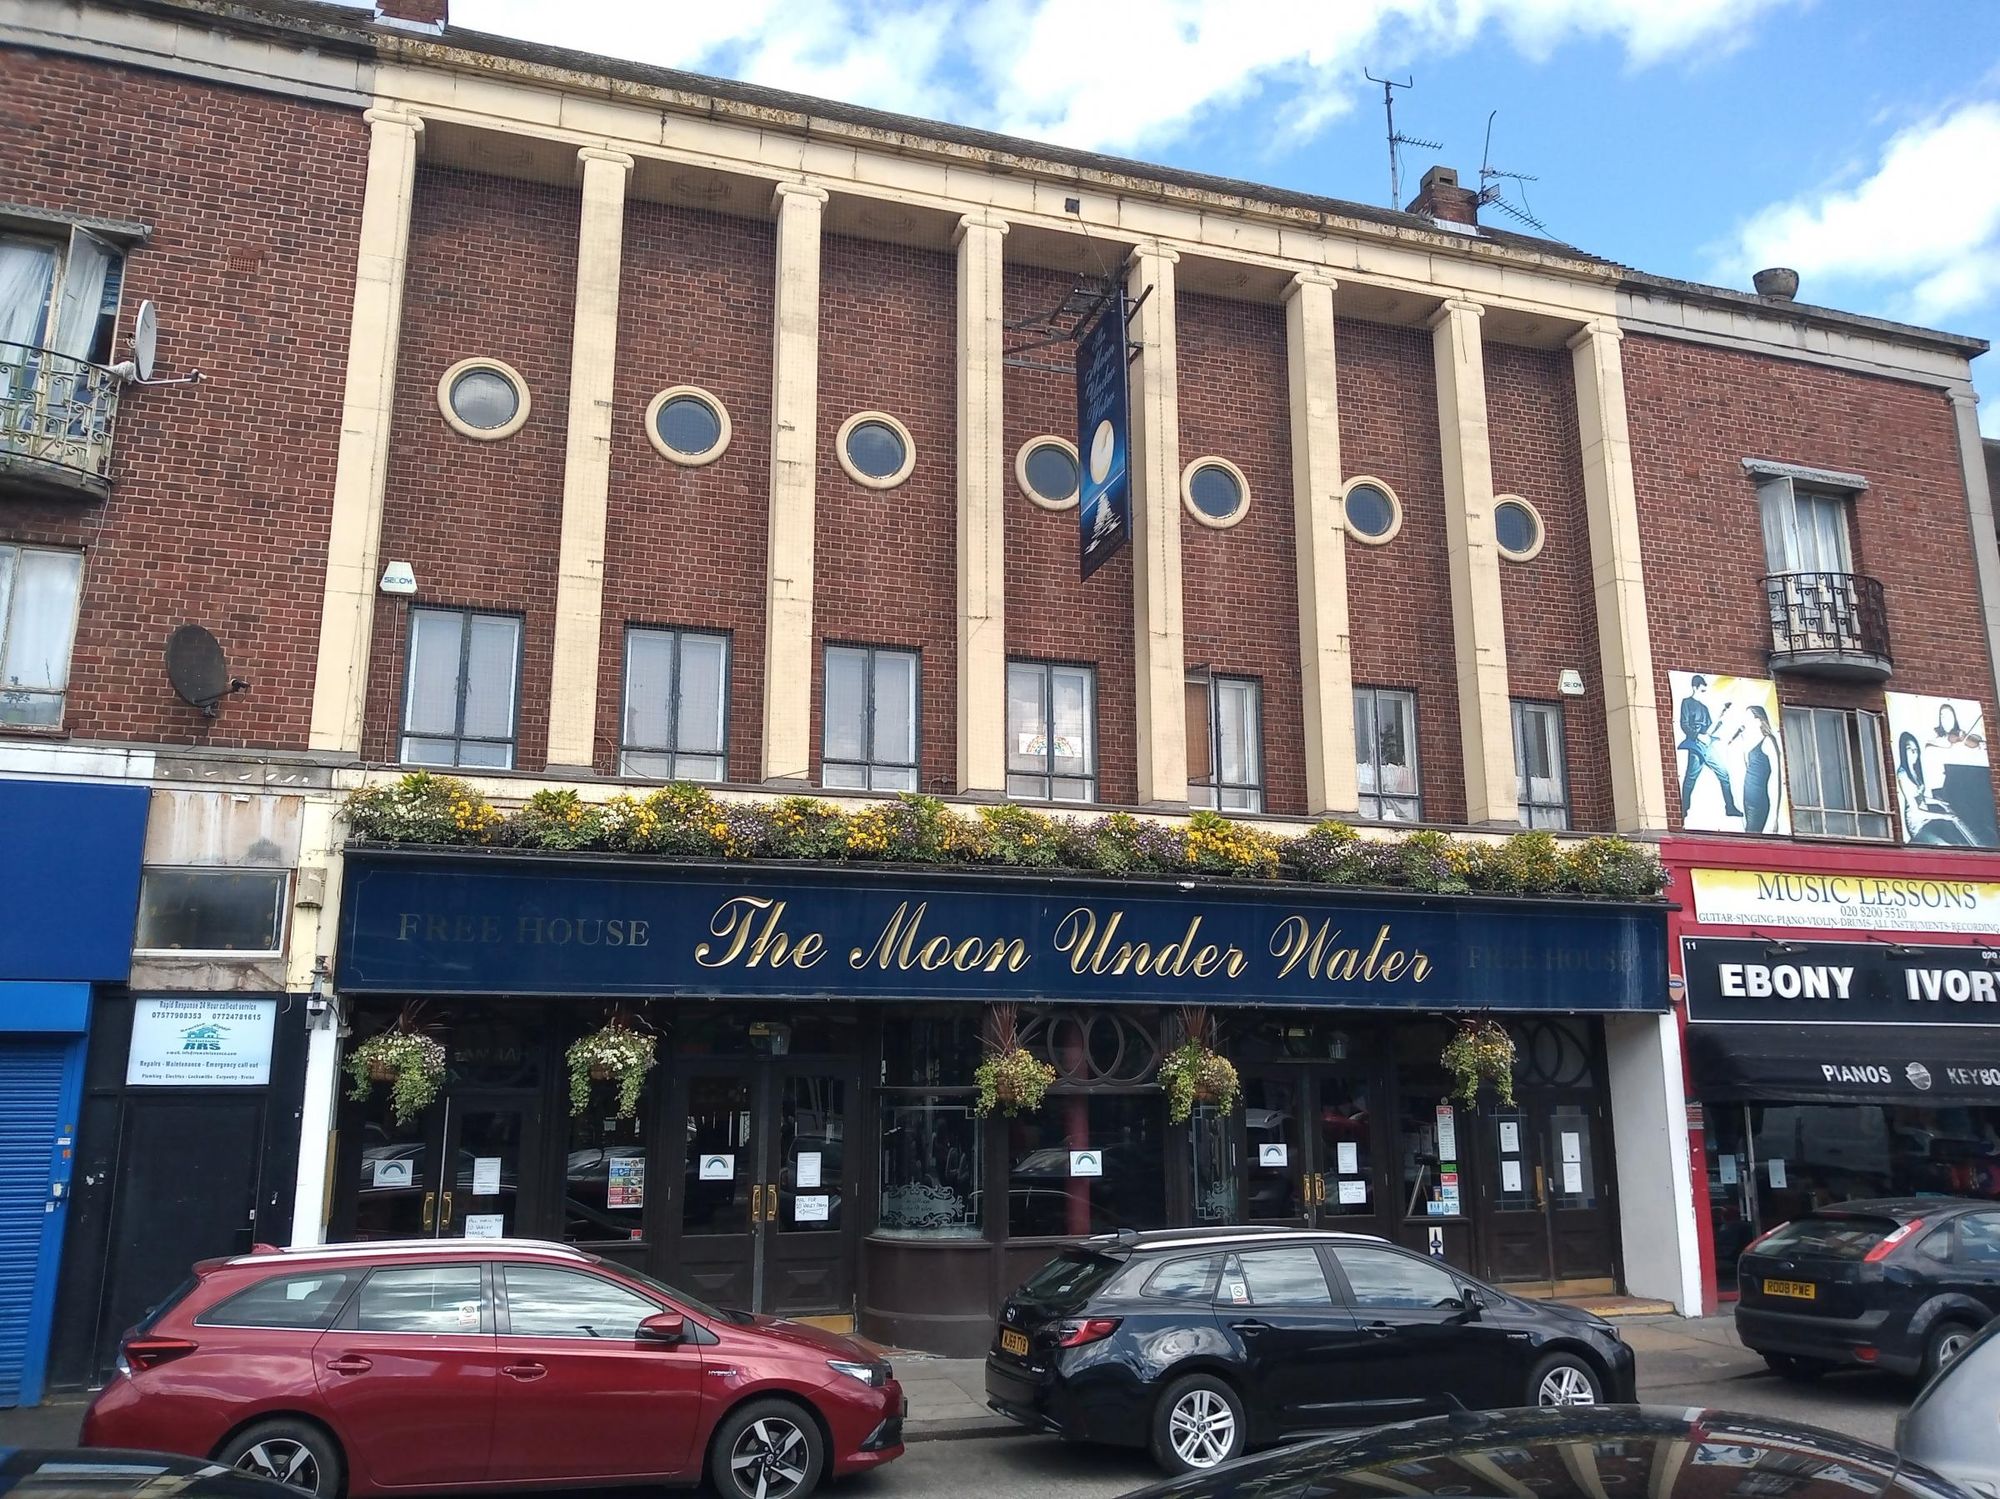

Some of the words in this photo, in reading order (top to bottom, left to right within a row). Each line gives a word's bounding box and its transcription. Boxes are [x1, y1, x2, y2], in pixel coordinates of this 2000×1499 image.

[1754, 874, 1851, 904] MUSIC
[1856, 878, 1977, 910] LESSONS
[1840, 905, 1858, 917] 020
[1860, 906, 1882, 918] 8200
[1884, 907, 1908, 919] 5510
[397, 912, 501, 943] FREE
[516, 915, 650, 948] HOUSE
[695, 896, 828, 969] The
[849, 900, 1031, 973] Moon
[1053, 907, 1249, 980] Under
[1269, 915, 1433, 984] Water
[1685, 941, 1697, 950] 11
[1718, 963, 1855, 999] EBONY
[159, 1000, 174, 1010] Rapid
[174, 1001, 199, 1010] Response
[206, 1001, 219, 1010] Hour
[139, 1060, 161, 1068] Repairs
[165, 1060, 201, 1068] Maintenance
[205, 1061, 237, 1069] Emergency
[1821, 1064, 1892, 1083] PIANOS
